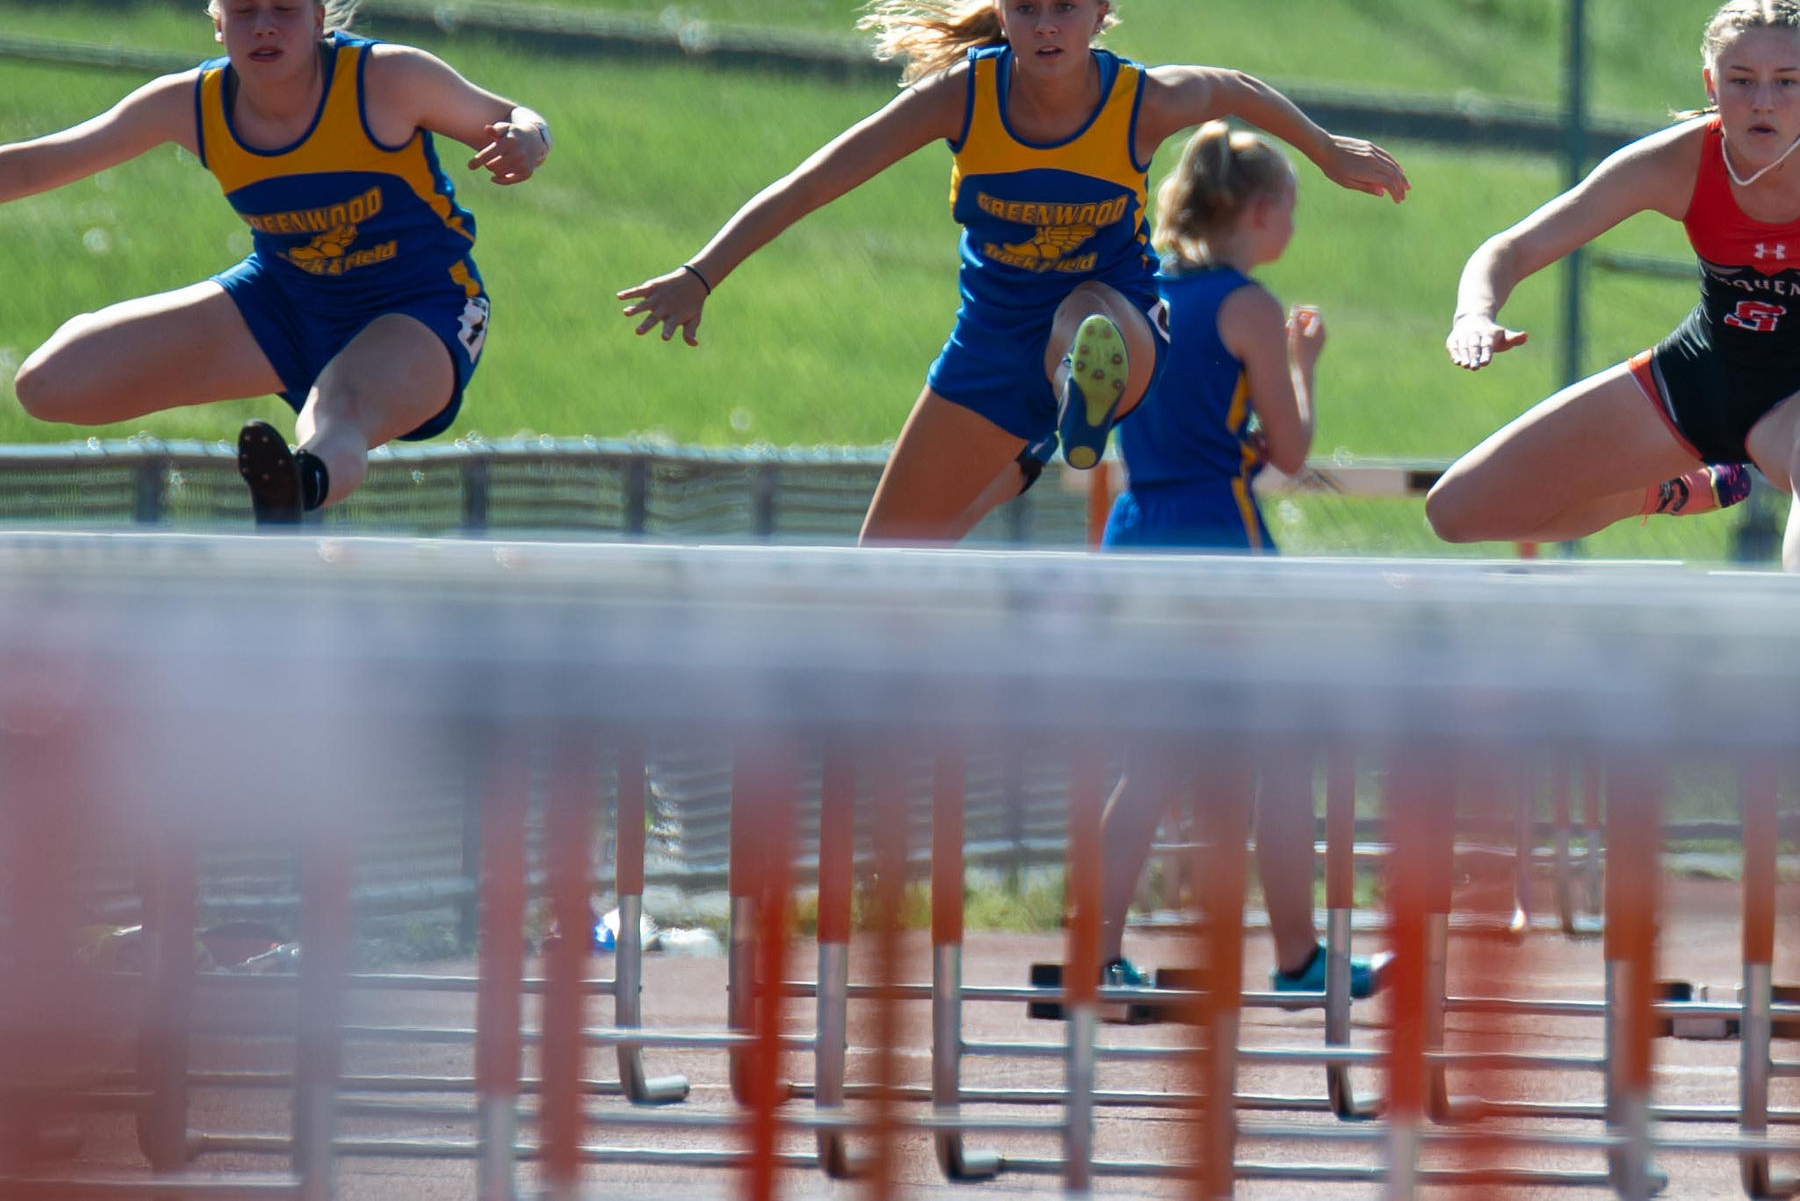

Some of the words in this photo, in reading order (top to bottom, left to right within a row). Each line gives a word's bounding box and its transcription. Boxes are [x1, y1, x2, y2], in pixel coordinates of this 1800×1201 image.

[241, 186, 383, 234] REENWOOD
[976, 190, 1130, 227] GREENWOOD
[344, 239, 398, 272] Field
[1724, 299, 1787, 332] S
